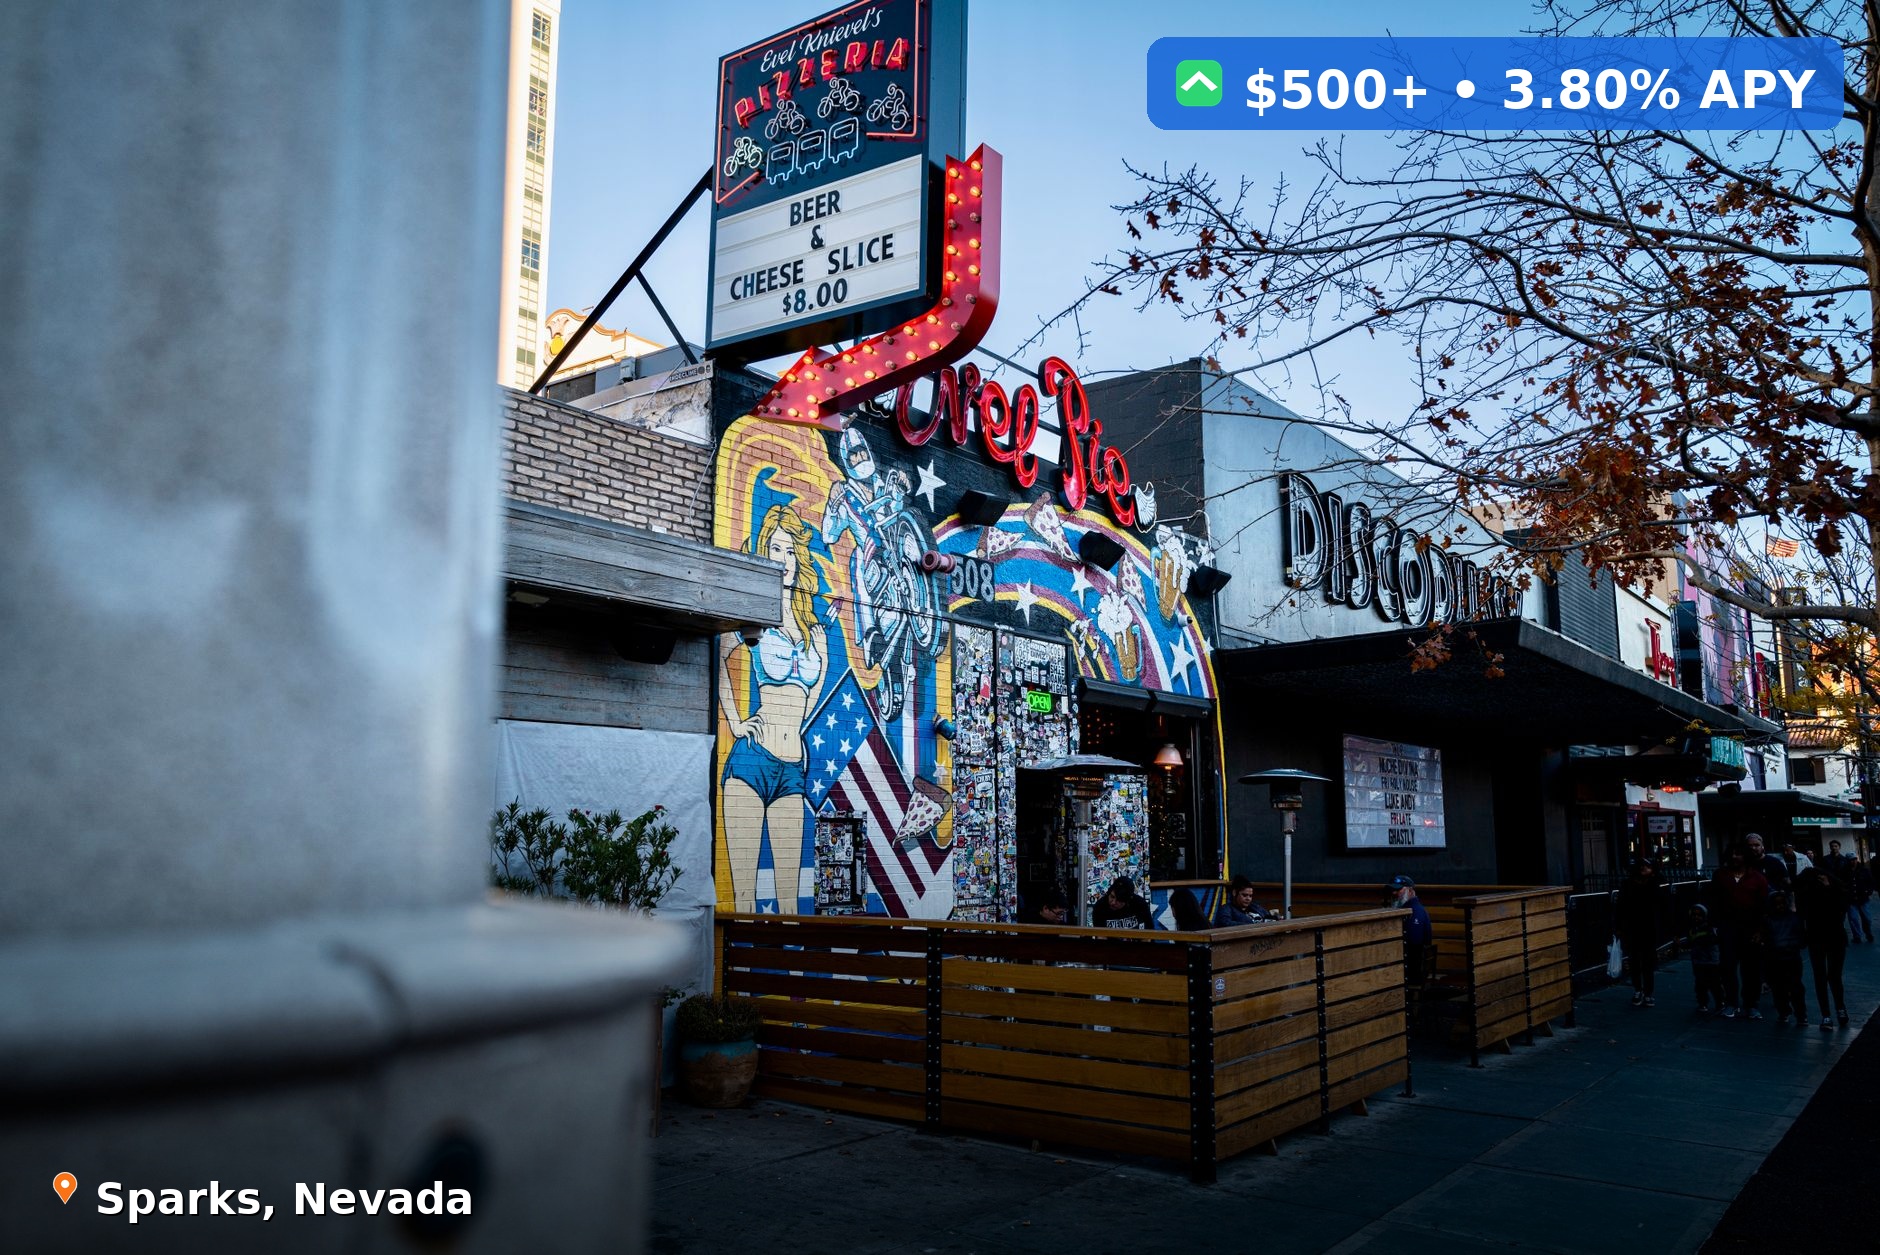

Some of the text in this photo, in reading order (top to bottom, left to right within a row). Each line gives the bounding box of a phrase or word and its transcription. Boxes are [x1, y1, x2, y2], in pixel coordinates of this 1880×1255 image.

[760, 7, 883, 73] Evel Knievel's
[734, 37, 909, 129] PIZZERIA
[789, 190, 841, 227] BEER
[810, 224, 825, 250] &
[730, 233, 894, 301] CHEESE SLICE
[782, 278, 848, 316] $8.00
[1038, 355, 1136, 528] Pie
[950, 556, 995, 601] 508
[1028, 693, 1050, 710] OPEN
[1388, 828, 1415, 845] GHASTLY
